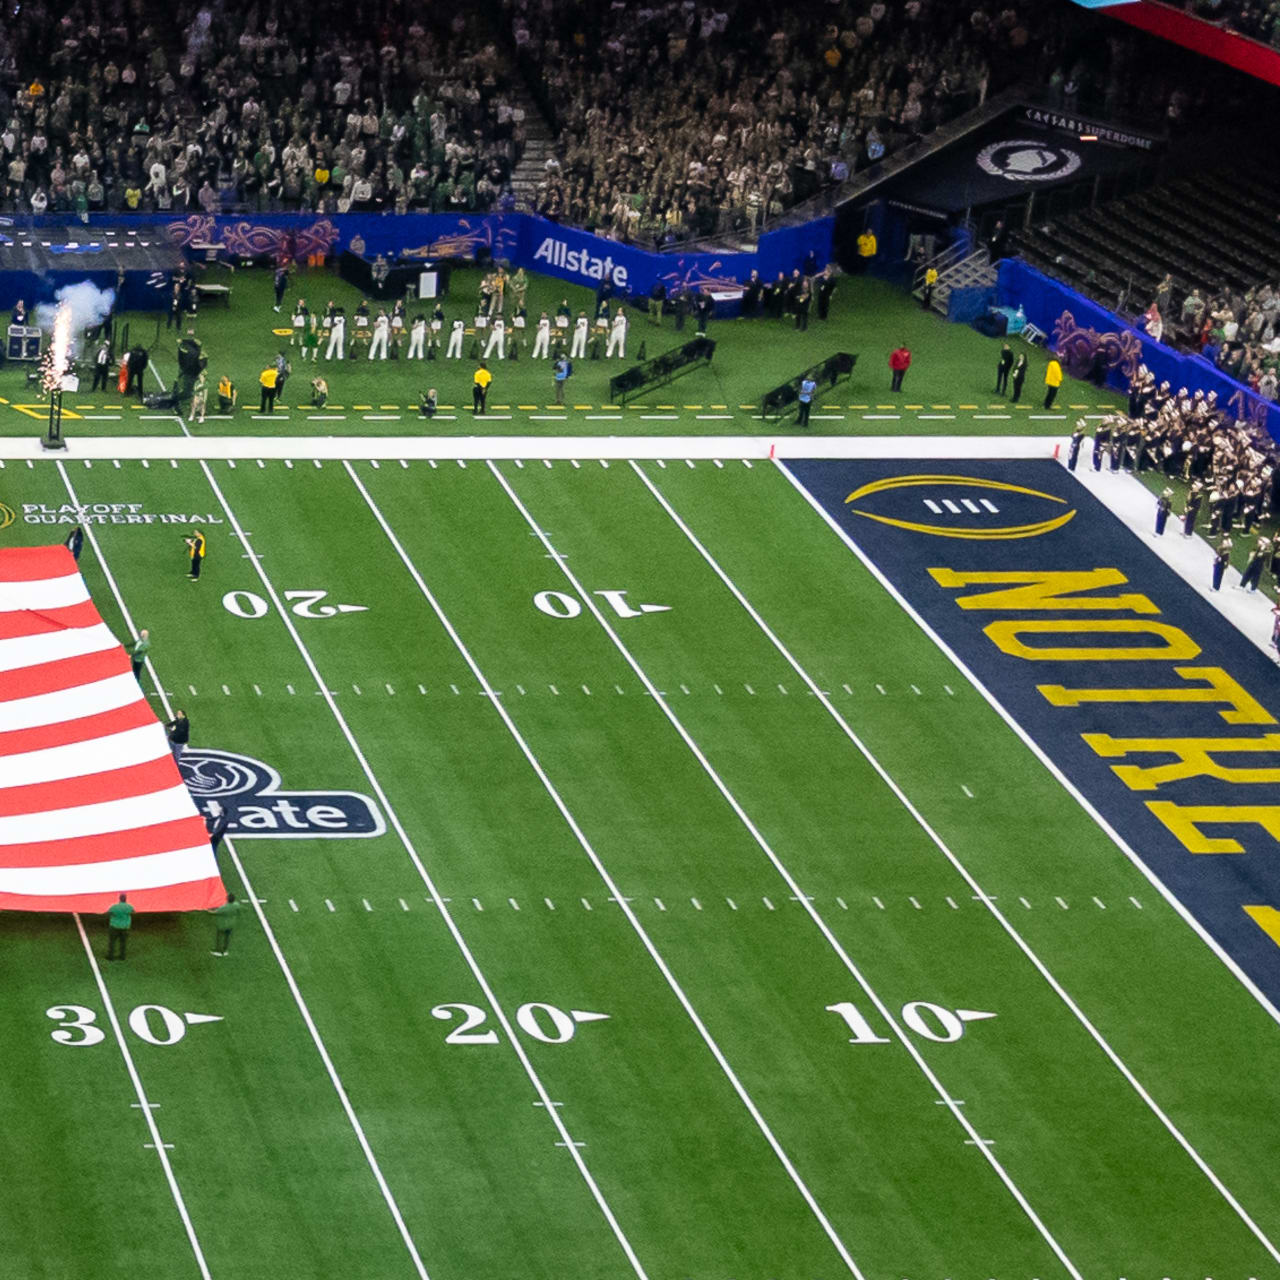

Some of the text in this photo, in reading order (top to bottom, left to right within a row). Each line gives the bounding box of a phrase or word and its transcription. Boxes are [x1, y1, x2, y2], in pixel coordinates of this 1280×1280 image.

[1025, 108, 1153, 151] CAESARS SUPERDOME
[533, 237, 629, 288] Allstate
[22, 503, 143, 515] PLAYOFF
[23, 513, 224, 524] QUARTERFINAL
[926, 568, 1280, 854] NOTRE
